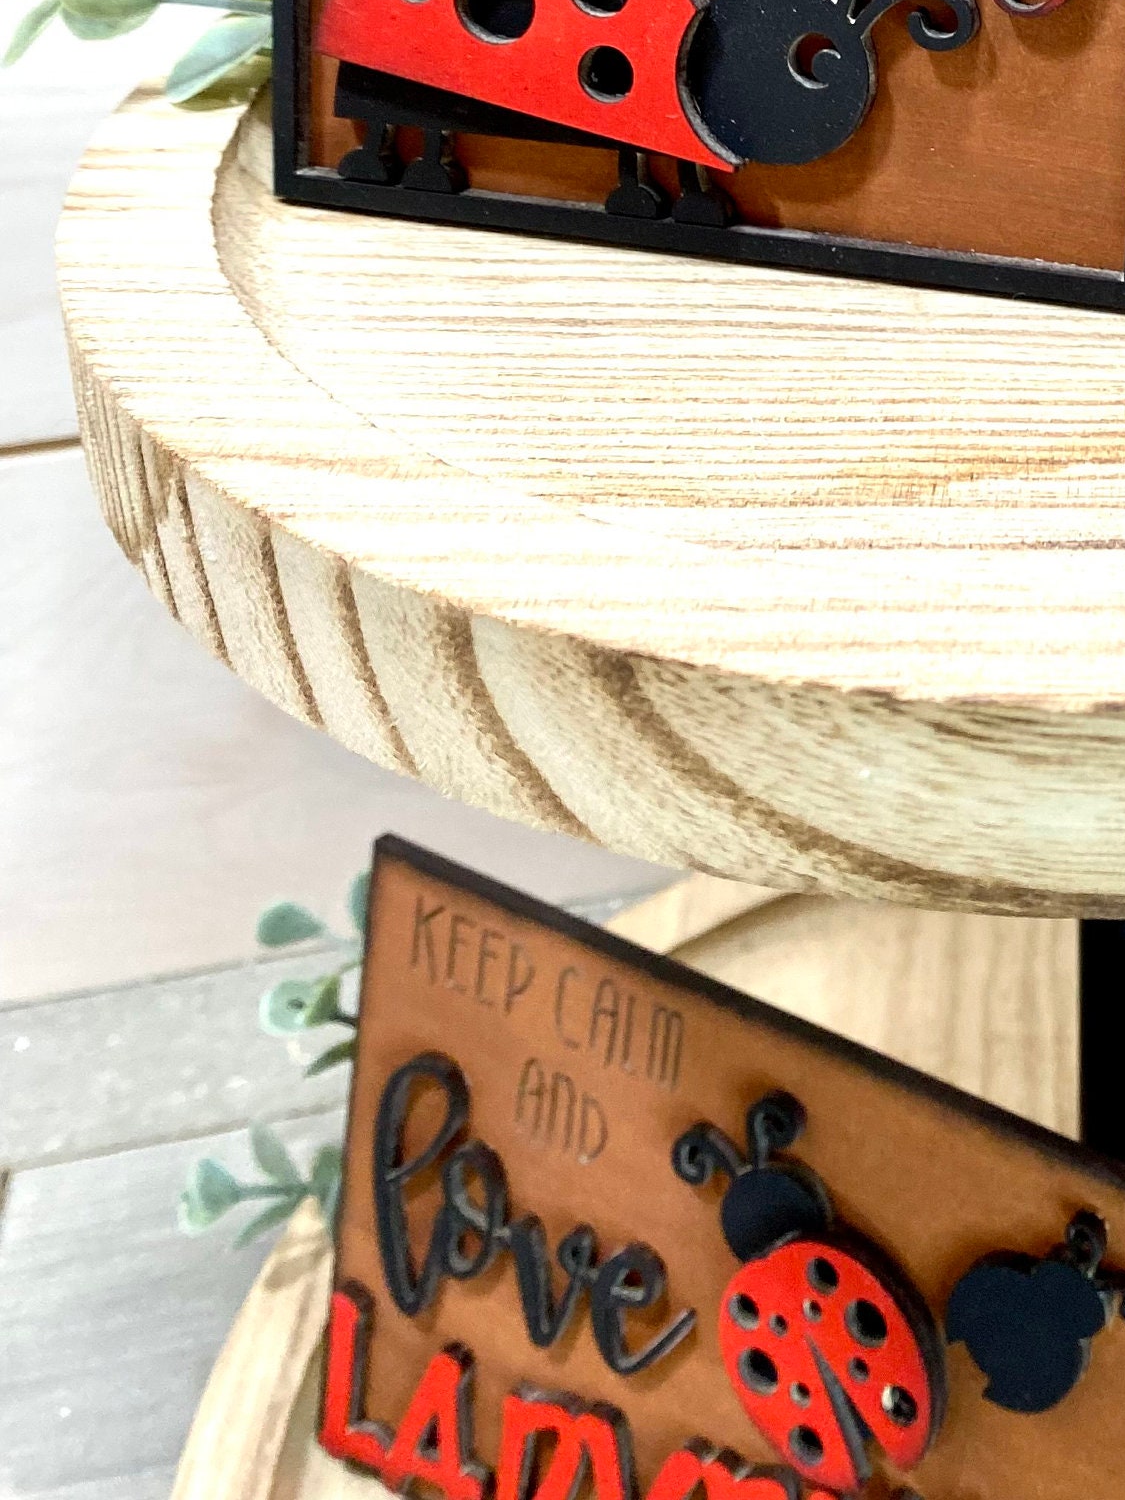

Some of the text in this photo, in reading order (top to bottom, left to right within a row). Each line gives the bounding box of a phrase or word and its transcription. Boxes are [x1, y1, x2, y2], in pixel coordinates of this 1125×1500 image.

[410, 895, 685, 1094] KEEP CALM
[514, 1056, 609, 1165] AND
[372, 1051, 698, 1377] love
